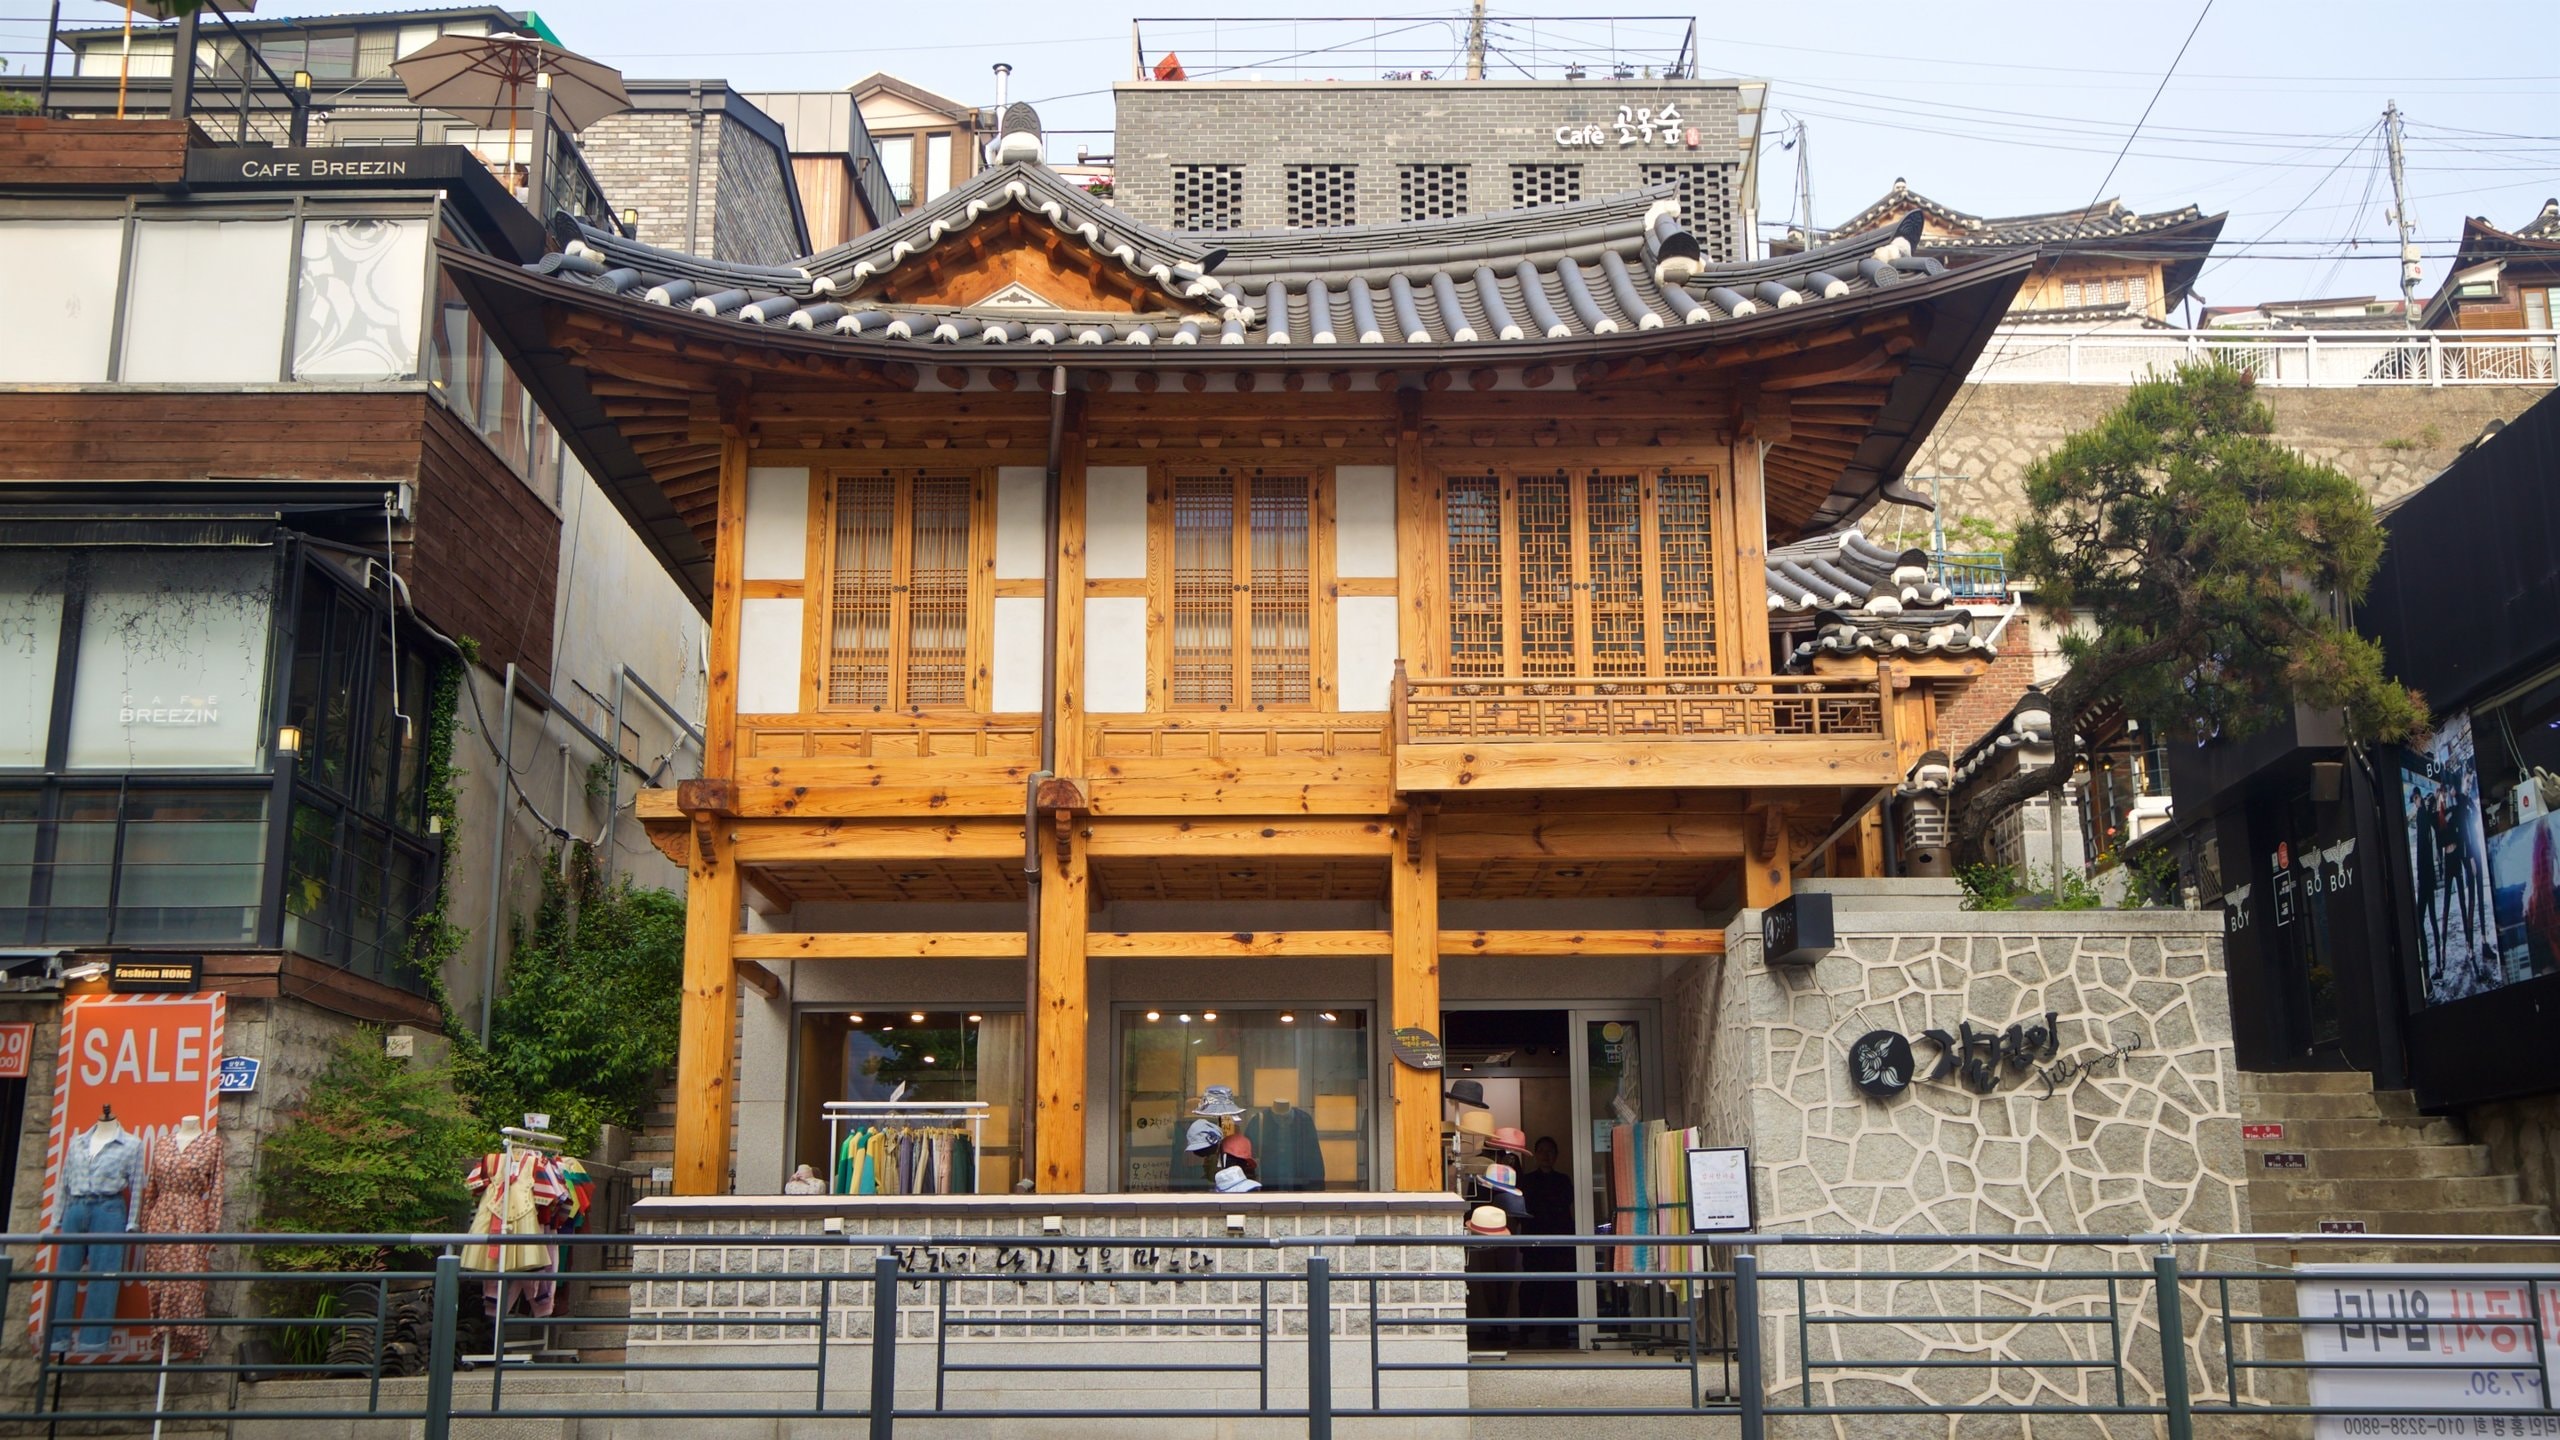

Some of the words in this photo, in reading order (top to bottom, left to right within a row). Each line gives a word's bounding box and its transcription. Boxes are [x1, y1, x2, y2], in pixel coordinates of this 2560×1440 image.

[1612, 102, 1684, 145] 골목숲
[241, 160, 300, 178] CAFE
[311, 159, 406, 176] BREEZIN
[119, 708, 217, 723] BREEZIN
[2329, 867, 2353, 893] BOY
[2230, 910, 2250, 932] BOY
[115, 968, 160, 979] Fashion
[161, 969, 192, 980] HONG
[80, 1026, 202, 1087] SALE
